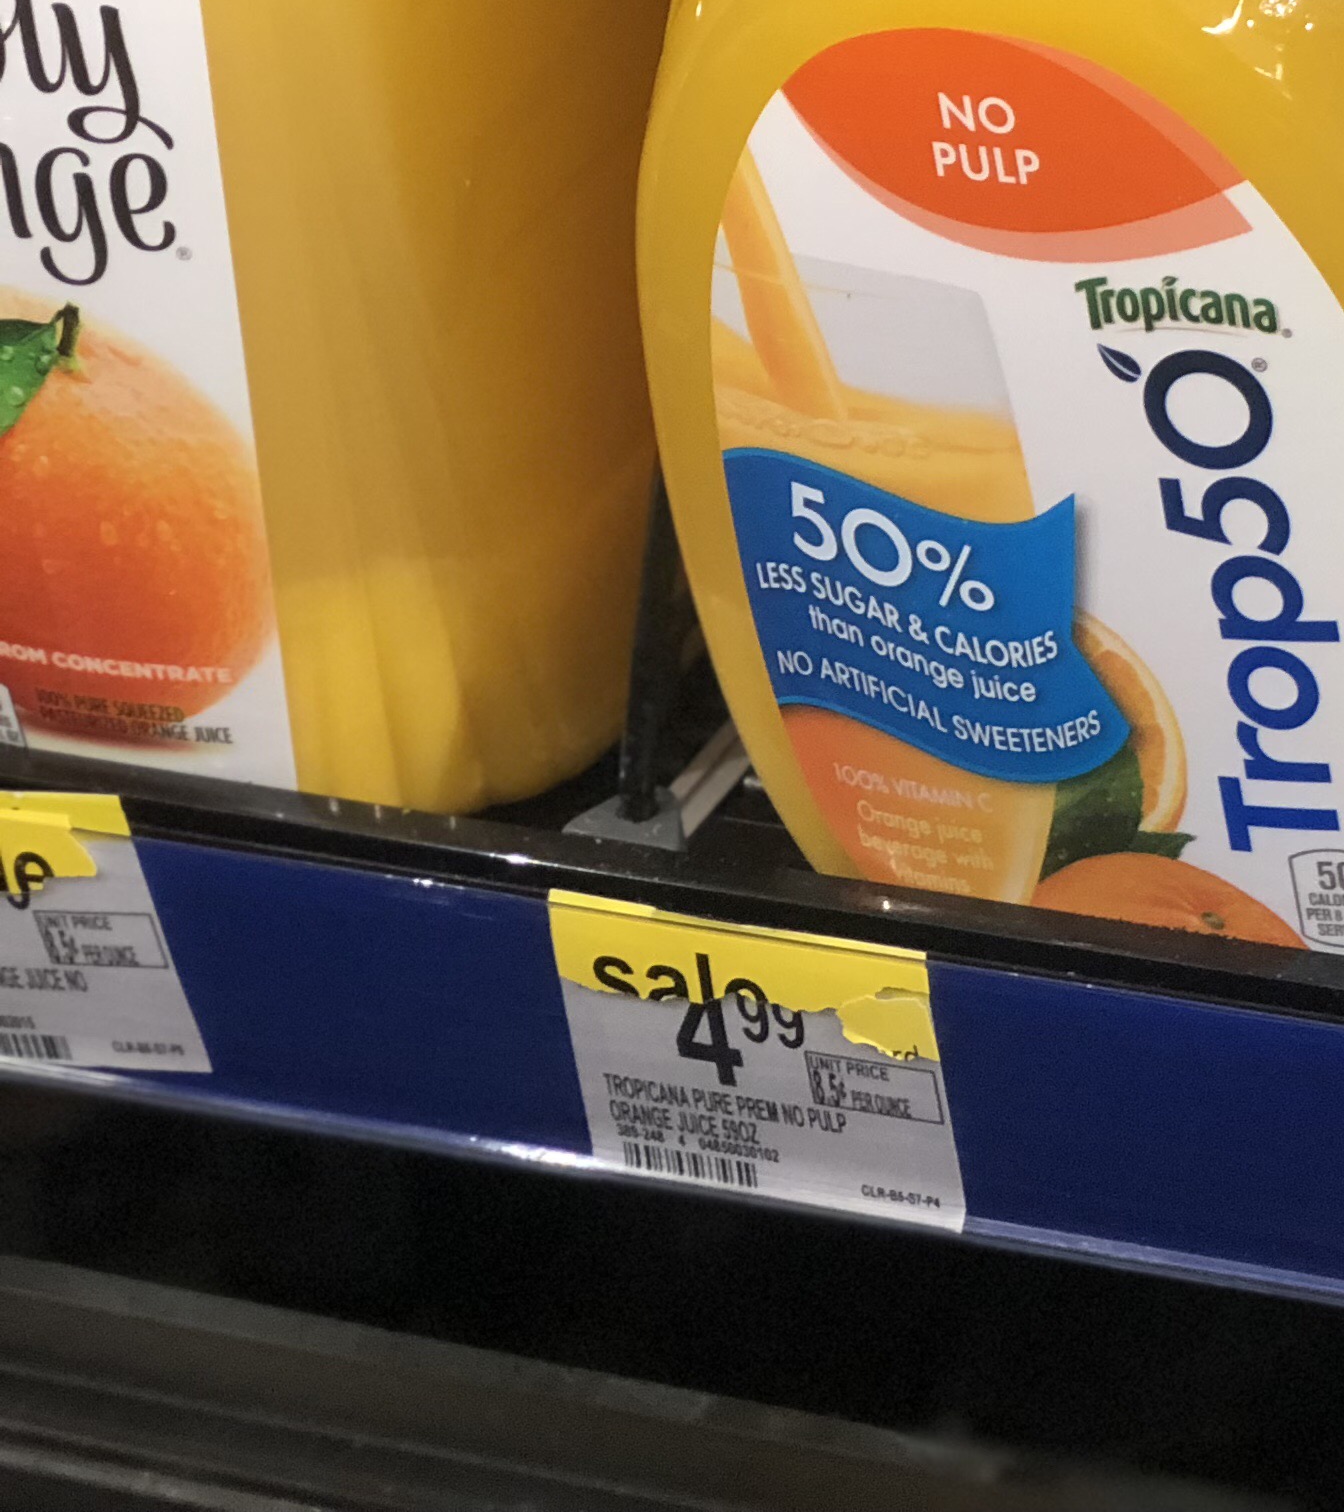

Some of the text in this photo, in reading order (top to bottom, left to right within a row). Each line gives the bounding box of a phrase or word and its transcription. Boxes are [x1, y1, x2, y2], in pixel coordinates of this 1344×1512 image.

[937, 92, 1016, 135] NO
[931, 140, 1041, 186] PULP
[1075, 276, 1281, 334] Tropicana
[789, 481, 996, 612] 50%
[756, 561, 1059, 669] LESS SUGAR & CALORIES
[1142, 348, 1341, 853] Trop50
[0, 641, 233, 683] ROM CONCENTRATE
[808, 604, 1037, 703] than orange juice
[776, 650, 1101, 753] NO ARTIFICIAL SWEETENERS
[194, 725, 234, 744] JUICE
[833, 761, 994, 814] 100% VITAMIN C
[856, 799, 983, 844] Orange juice
[857, 822, 949, 869] beverage
[1306, 907, 1332, 922] PER
[808, 1056, 890, 1082] UNIT PRICE
[602, 1072, 847, 1133] TROPICANA PURE PREM NO PULP
[608, 1099, 673, 1131] ORANGE
[676, 1110, 720, 1139] JUICE
